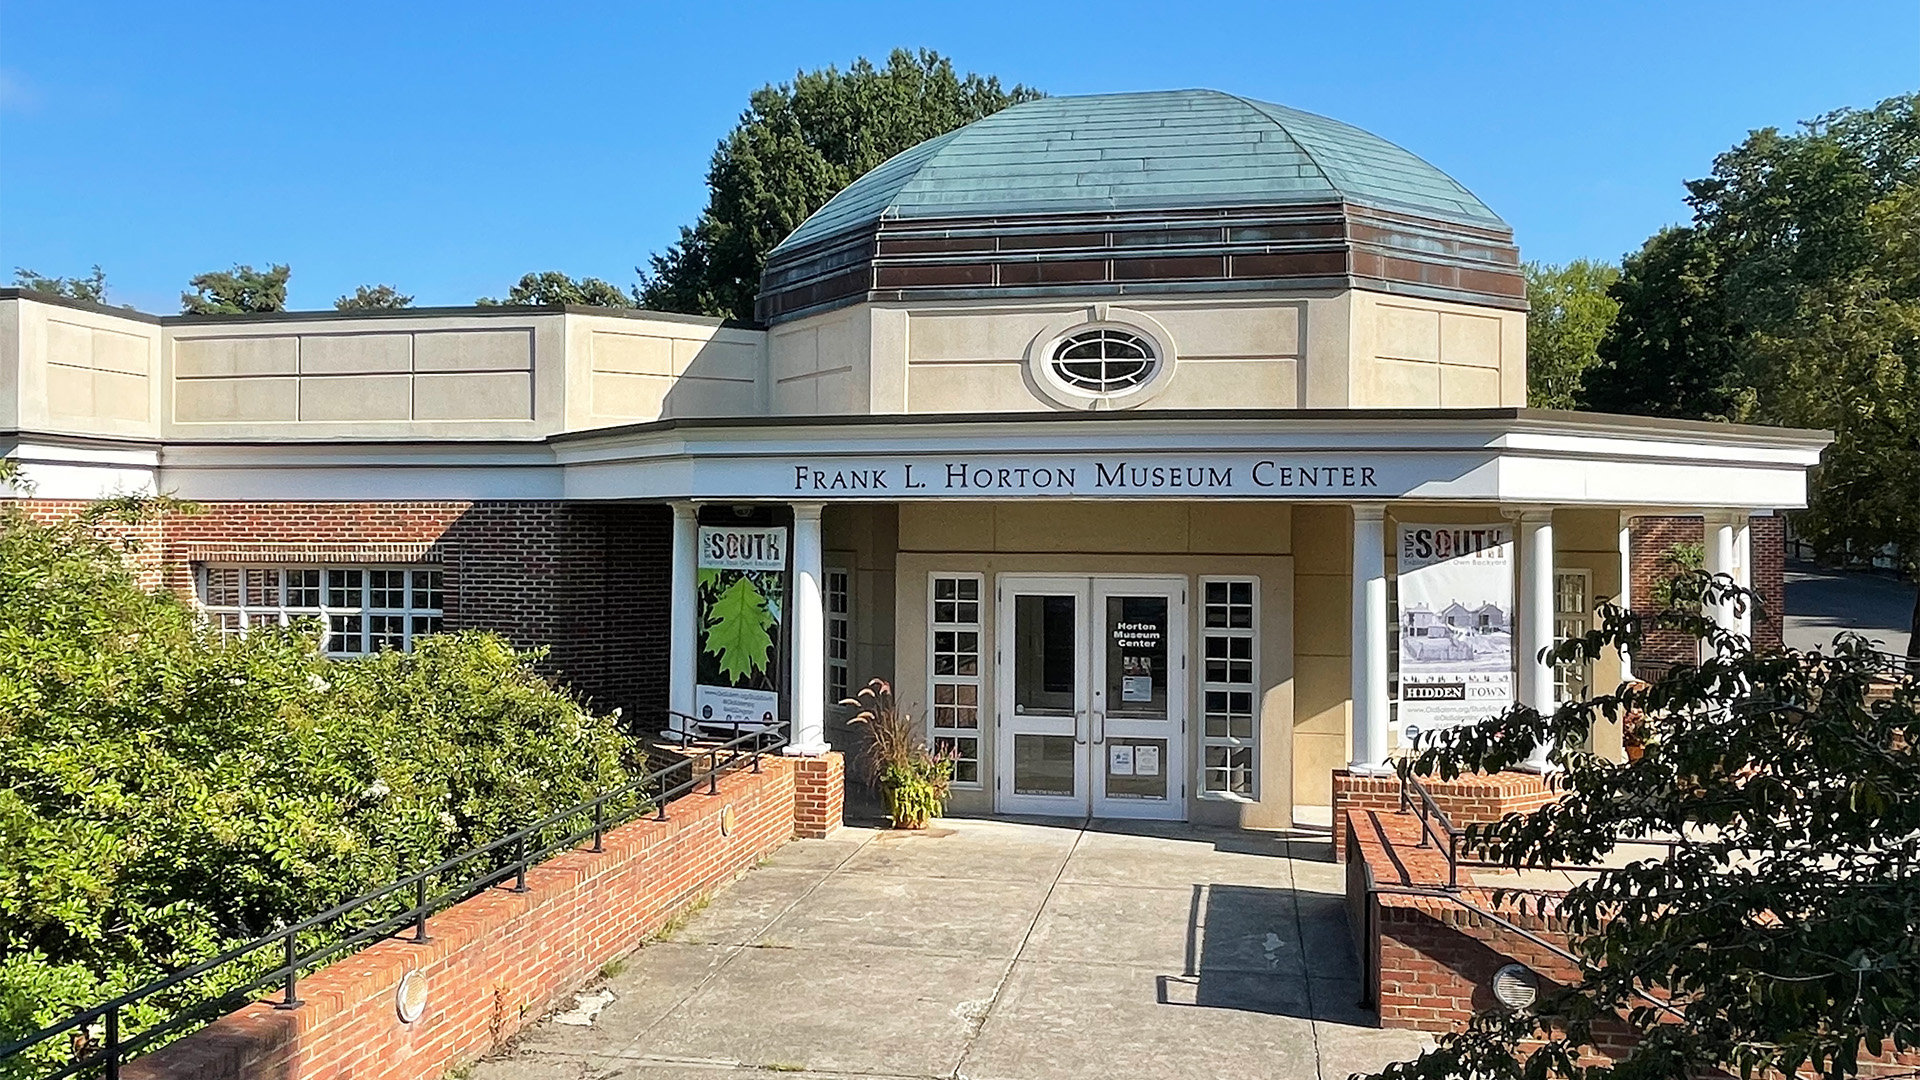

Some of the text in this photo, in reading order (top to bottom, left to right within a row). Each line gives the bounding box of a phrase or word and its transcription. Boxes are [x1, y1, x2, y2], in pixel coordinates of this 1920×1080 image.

[795, 461, 1378, 490] FRANK L. HORTON MUSEUM CENTER
[711, 532, 780, 560] SOUTH
[1404, 529, 1415, 558] STUDY
[1415, 529, 1504, 558] SOUTH
[1113, 630, 1160, 639] Museum
[1117, 622, 1157, 630] Horton
[1118, 639, 1157, 647] Center
[1406, 687, 1507, 698] HIDDEN TOWN
